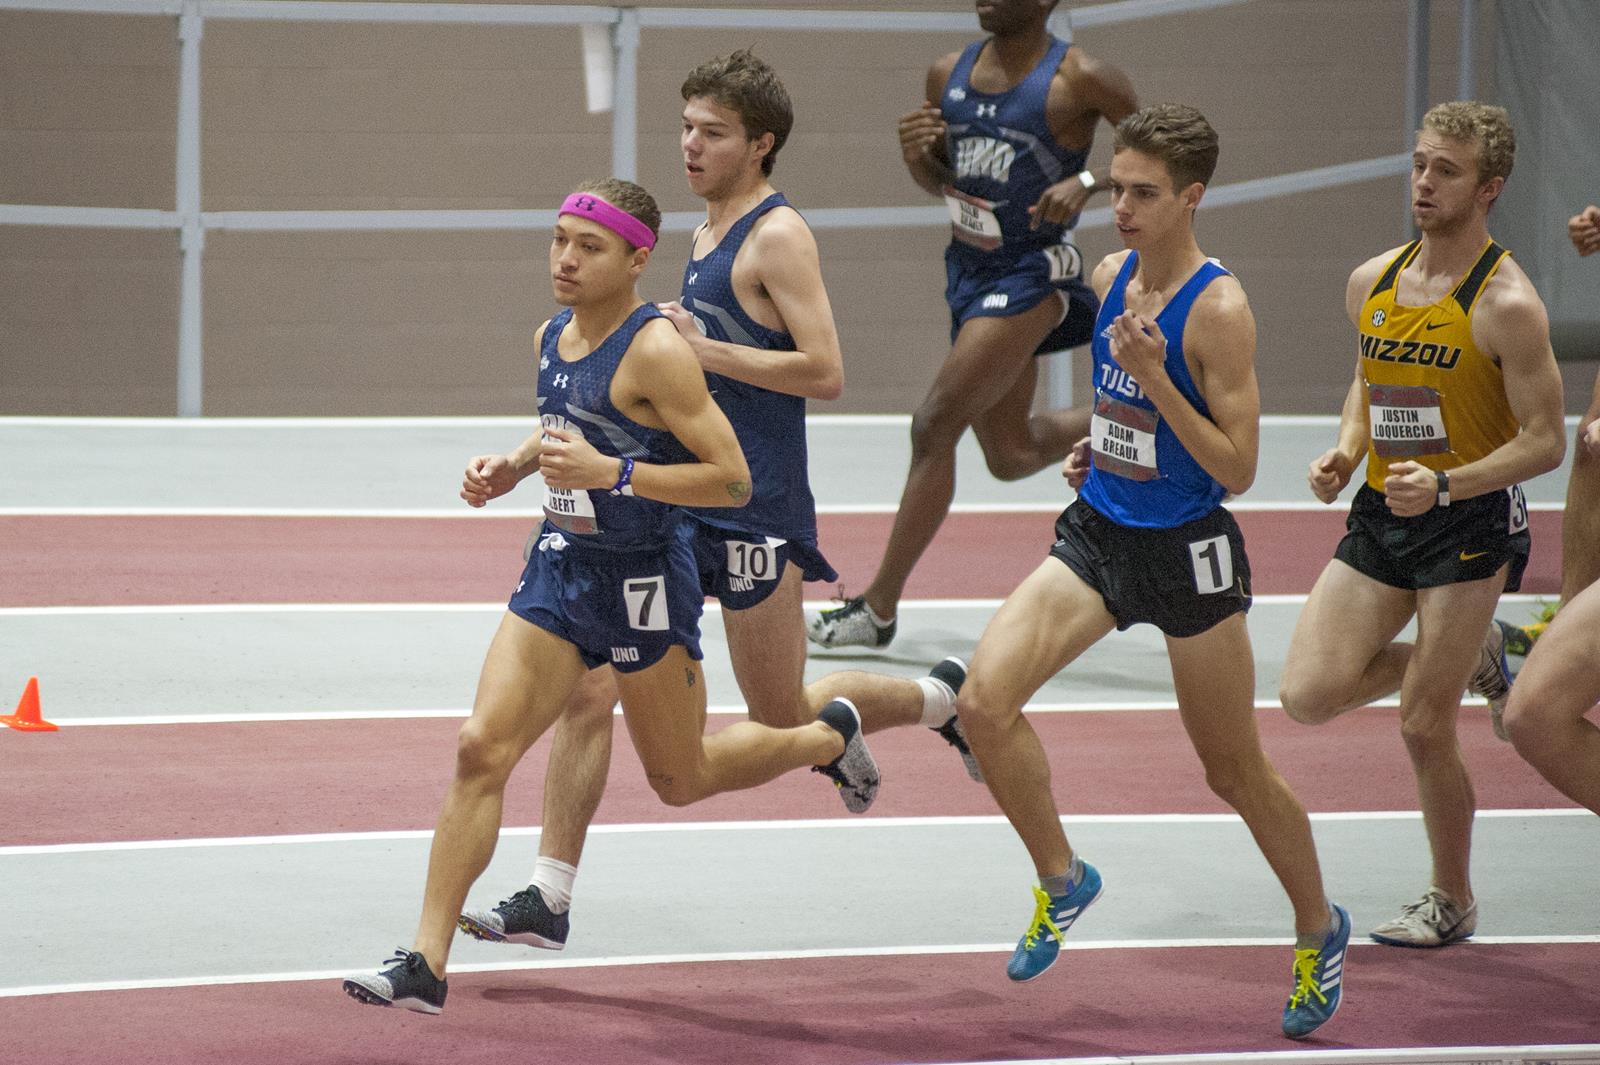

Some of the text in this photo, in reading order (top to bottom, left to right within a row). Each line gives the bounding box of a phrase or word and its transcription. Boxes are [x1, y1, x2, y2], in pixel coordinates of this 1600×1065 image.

[1053, 245, 1074, 277] 12
[983, 294, 1009, 309] UNO
[1360, 333, 1462, 370] MIZZOU
[1382, 409, 1419, 423] JUSTIN
[1108, 423, 1134, 445] ADAM
[1374, 424, 1435, 439] LOQUERCIO
[1102, 437, 1139, 463] BREAUX
[735, 543, 769, 578] 10
[1199, 541, 1224, 589] 1
[729, 576, 755, 592] UNO
[629, 581, 658, 627] 7
[611, 647, 639, 663] UNO
